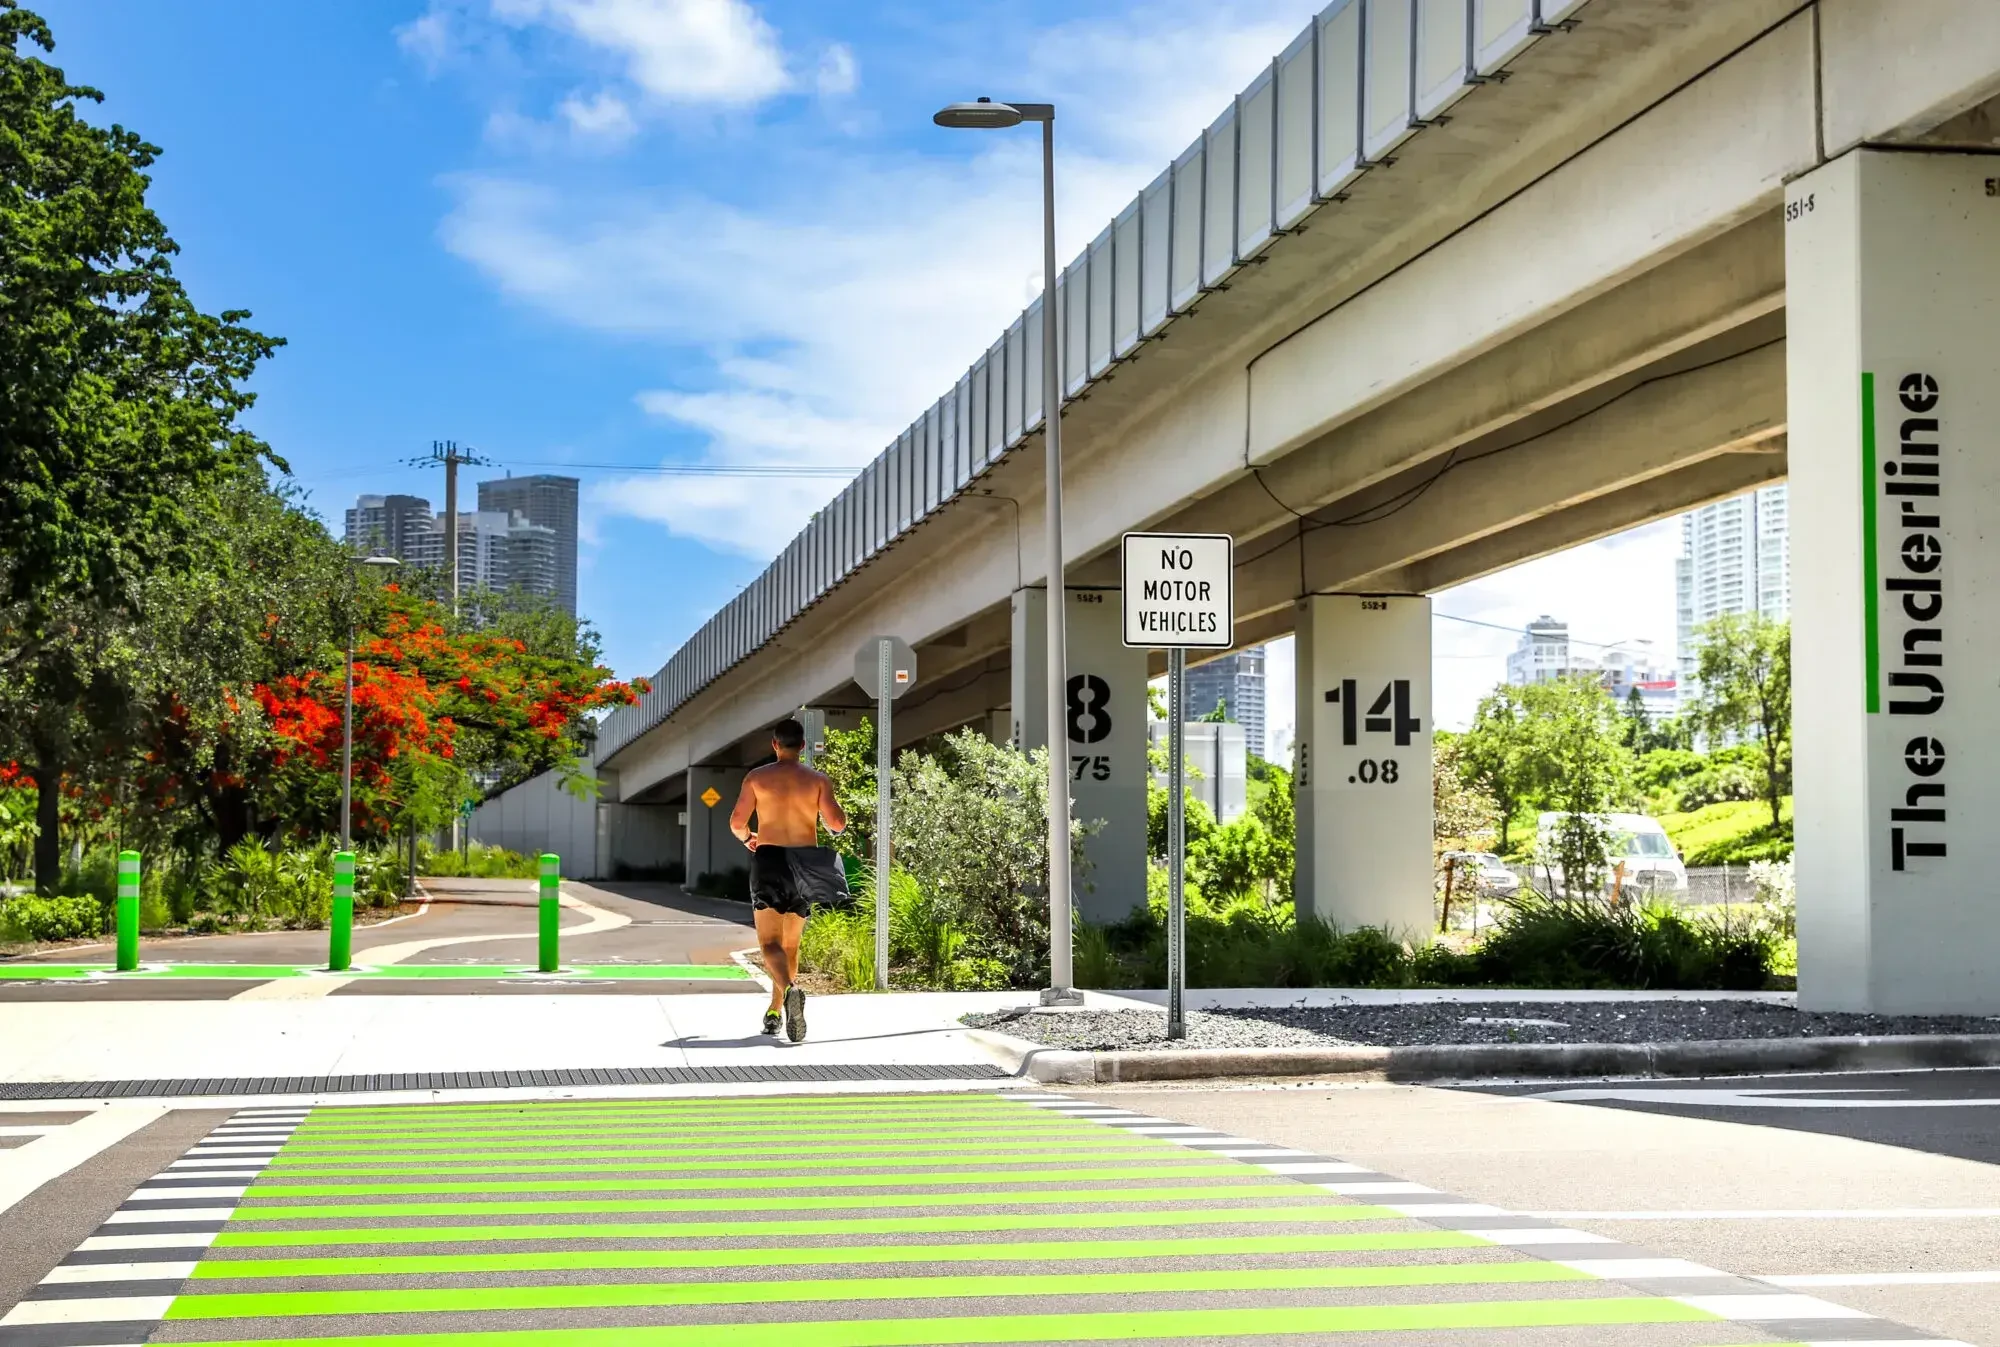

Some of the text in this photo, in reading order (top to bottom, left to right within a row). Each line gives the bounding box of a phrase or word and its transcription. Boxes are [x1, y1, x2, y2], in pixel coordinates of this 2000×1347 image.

[1786, 193, 1815, 222] 551-S
[1161, 549, 1193, 571] NO
[1144, 580, 1211, 602] MOTOR
[1138, 611, 1217, 633] VEHICLES
[1883, 372, 1947, 872] The Underline
[1066, 673, 1112, 744] 8
[1324, 678, 1421, 746] 14
[1348, 759, 1399, 784] .08
